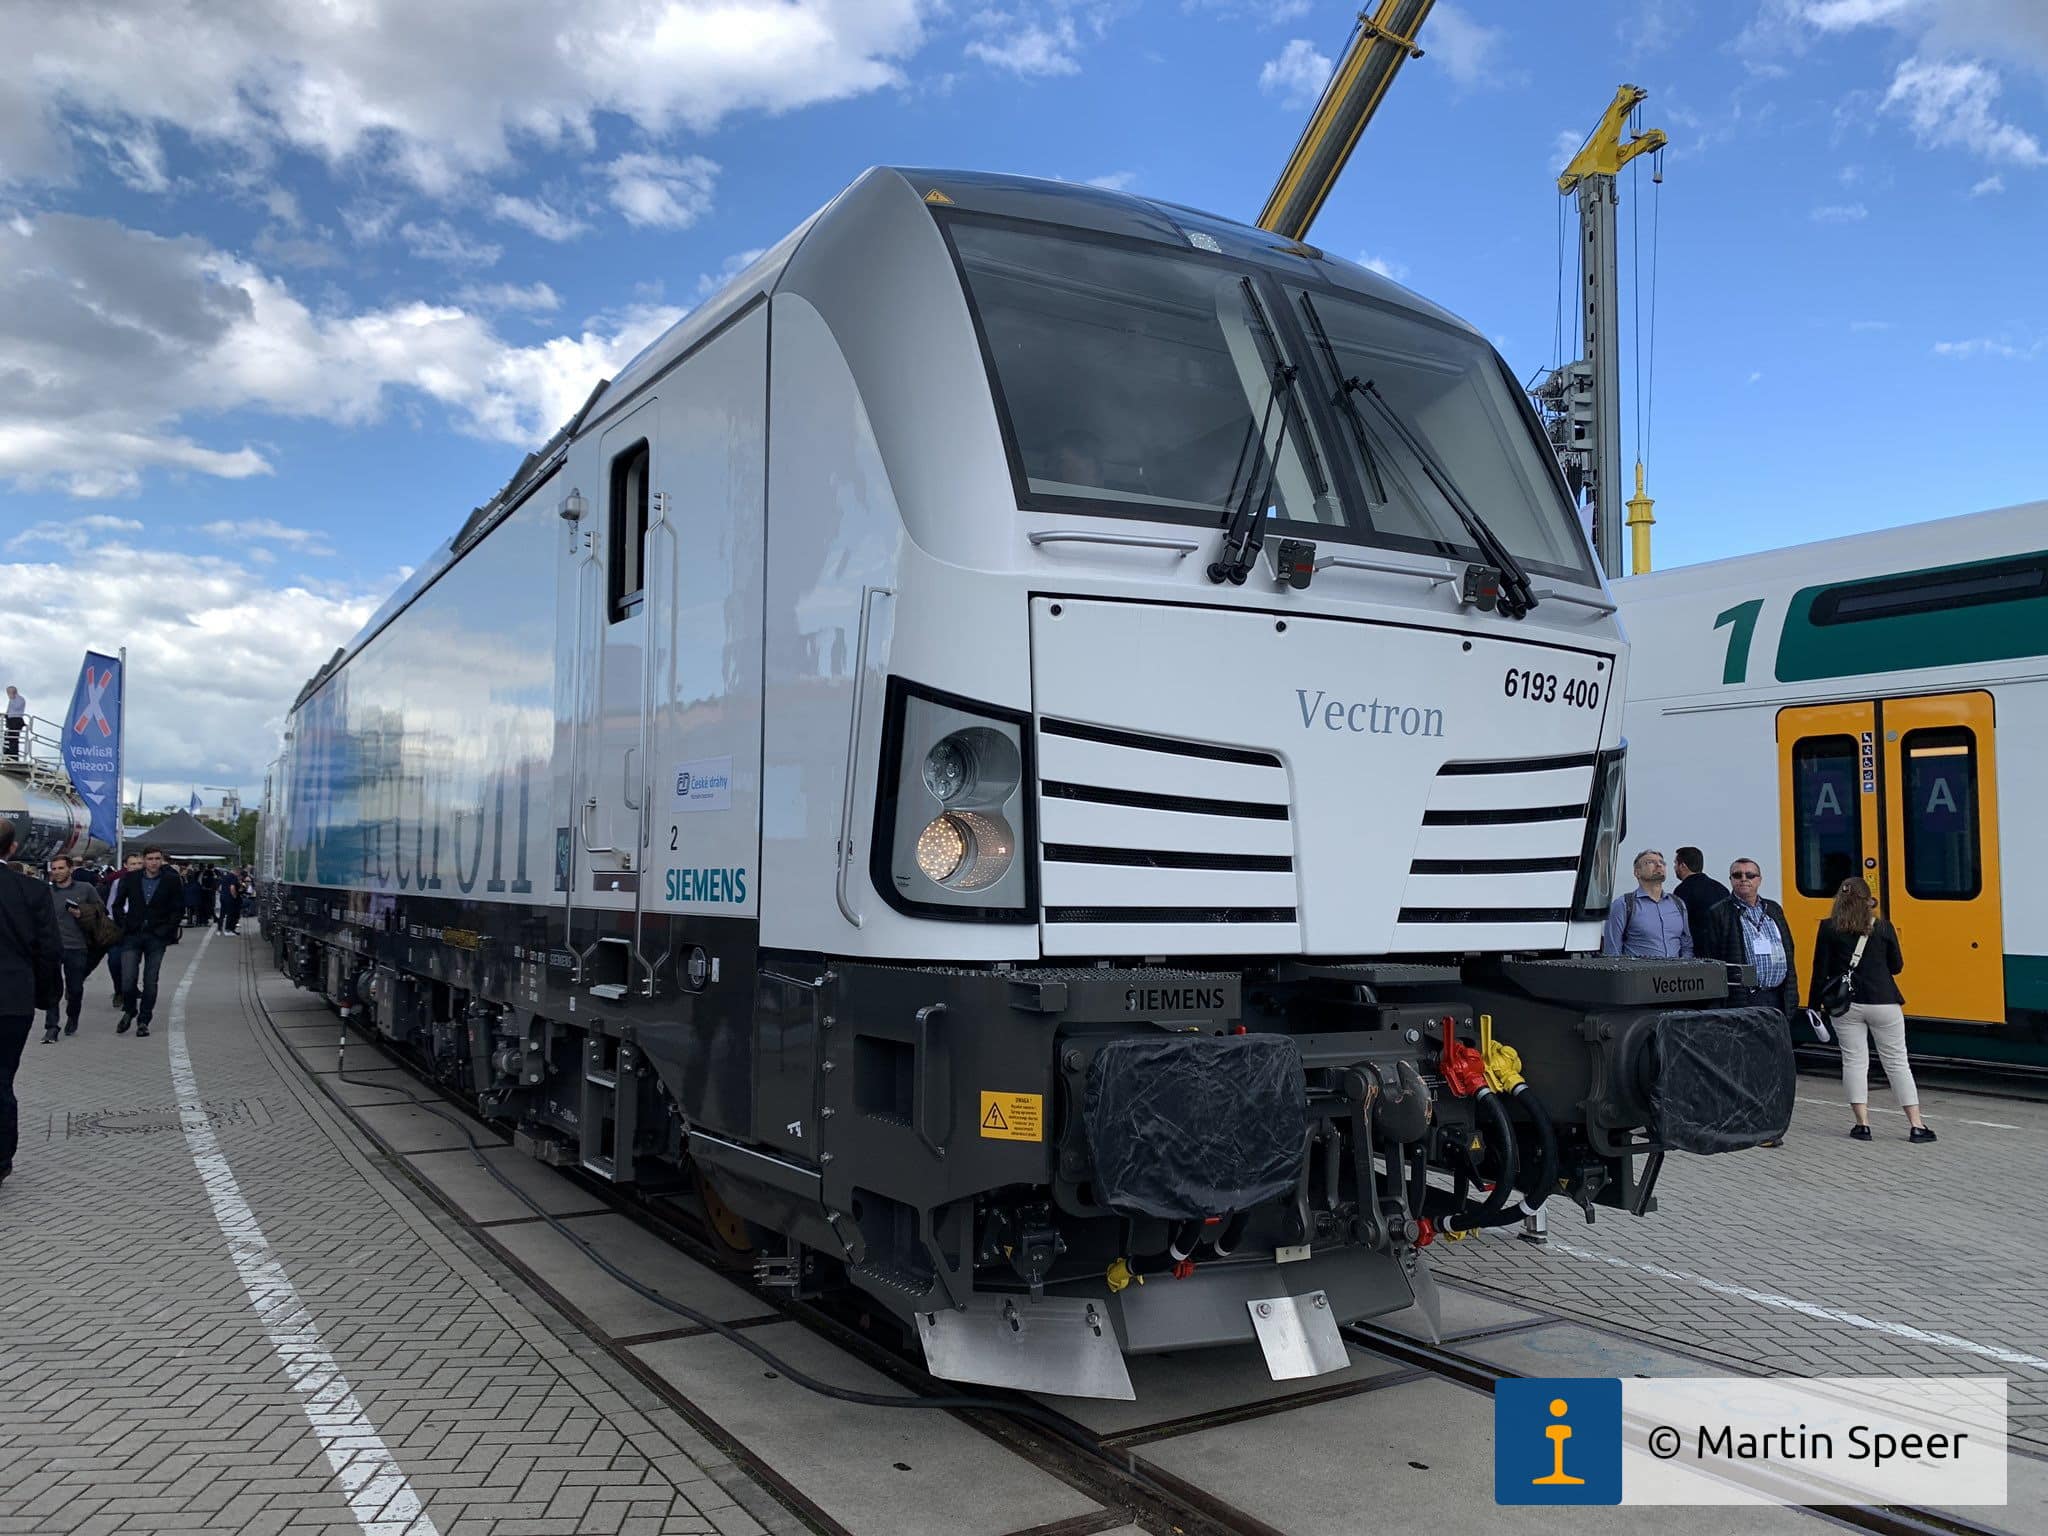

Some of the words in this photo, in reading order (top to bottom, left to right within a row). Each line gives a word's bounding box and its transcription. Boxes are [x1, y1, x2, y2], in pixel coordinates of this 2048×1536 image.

[1713, 598, 1765, 685] 1
[1504, 668, 1557, 704] 6193
[1563, 678, 1600, 710] 400
[1295, 689, 1445, 737] Vectron
[1814, 782, 1843, 817] A
[1925, 778, 1957, 814] A
[670, 825, 678, 851] 2
[665, 868, 747, 904] SIEMENS
[1125, 988, 1225, 1011] SIEMENS
[1652, 976, 1704, 993] Vectron
